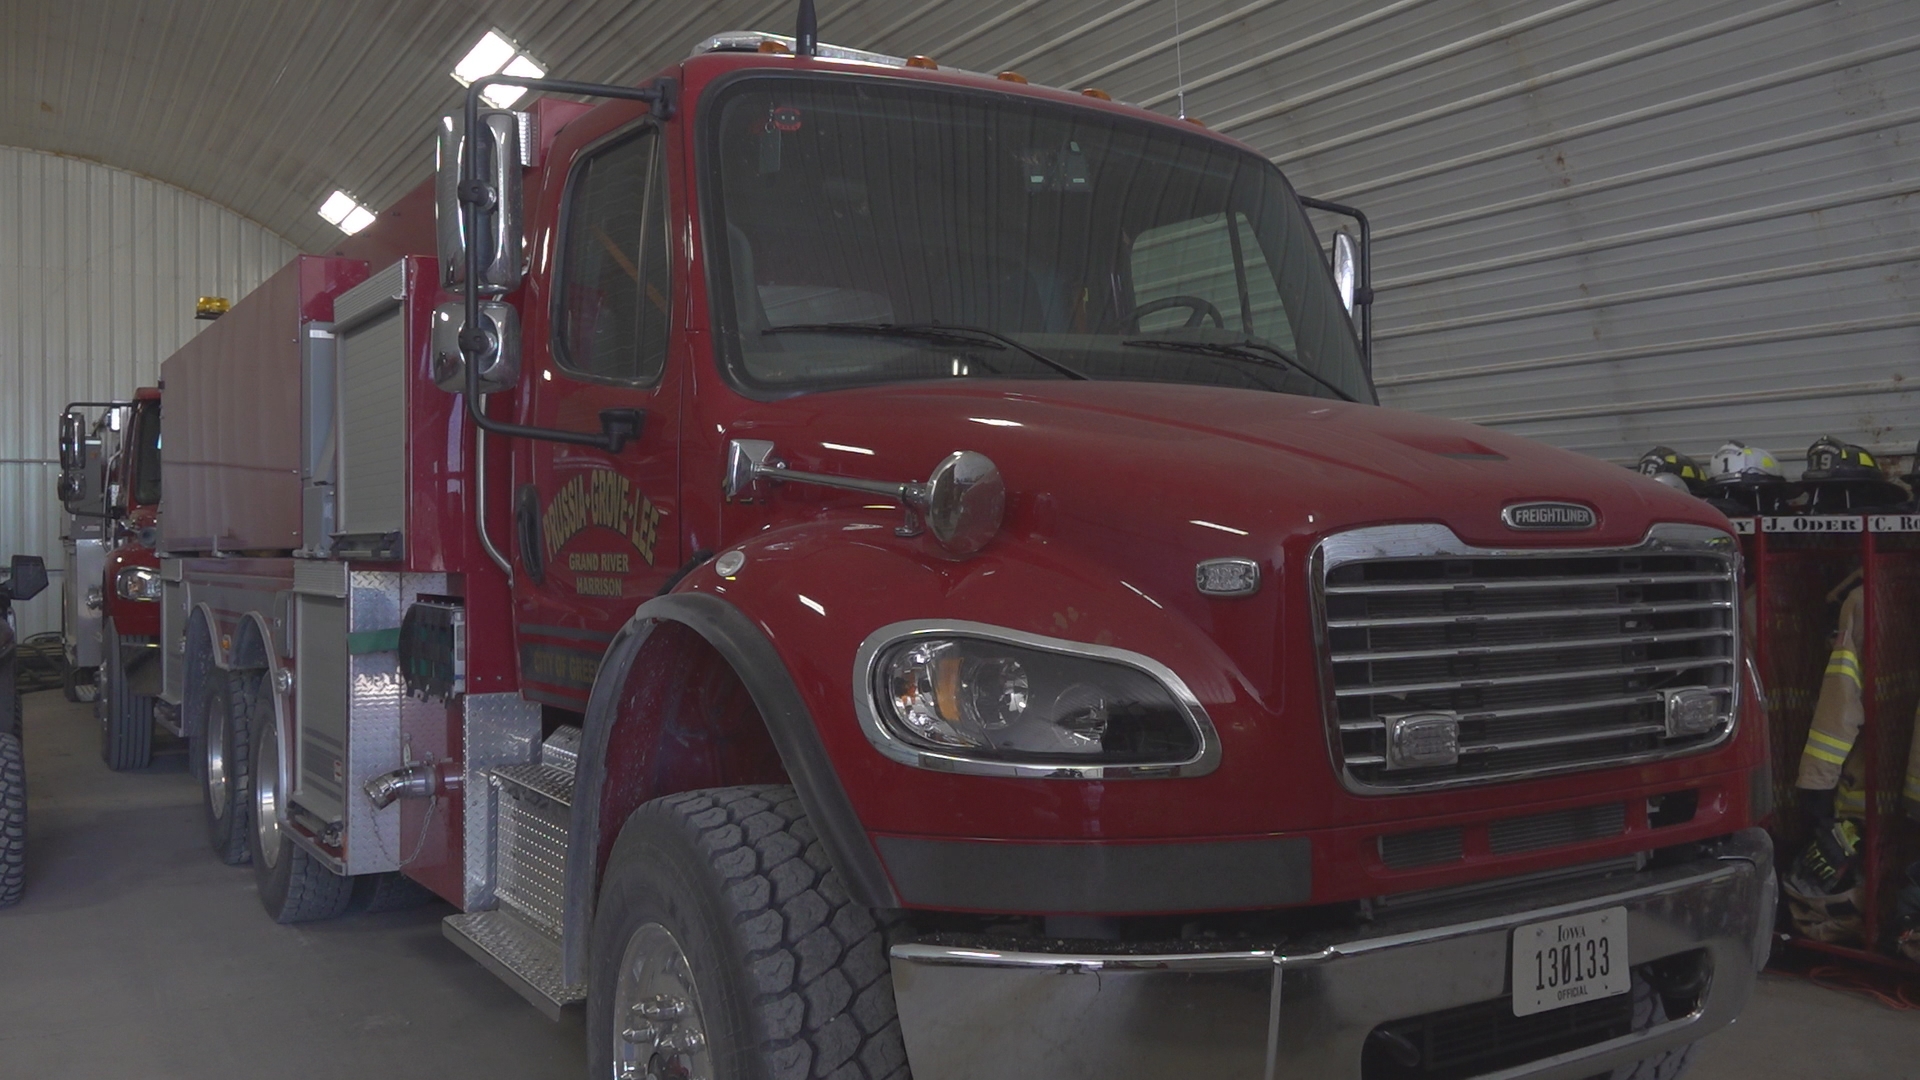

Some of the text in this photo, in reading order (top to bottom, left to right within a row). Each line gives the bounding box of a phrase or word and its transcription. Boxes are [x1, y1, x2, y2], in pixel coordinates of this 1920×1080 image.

[1640, 463, 1658, 477] 15
[1722, 457, 1730, 473] 1
[1811, 454, 1832, 471] 19
[542, 469, 660, 567] PRUSSIA GROVE LEE
[1515, 508, 1589, 523] FREIGHTLINER
[1765, 517, 1786, 531] J.
[1874, 517, 1893, 531] C.
[568, 552, 630, 573] GRAND RIVER
[576, 576, 623, 597] HARRISON
[555, 654, 567, 679] OF
[1535, 937, 1610, 991] 130133
[1557, 985, 1588, 1001] OFFICIAL
